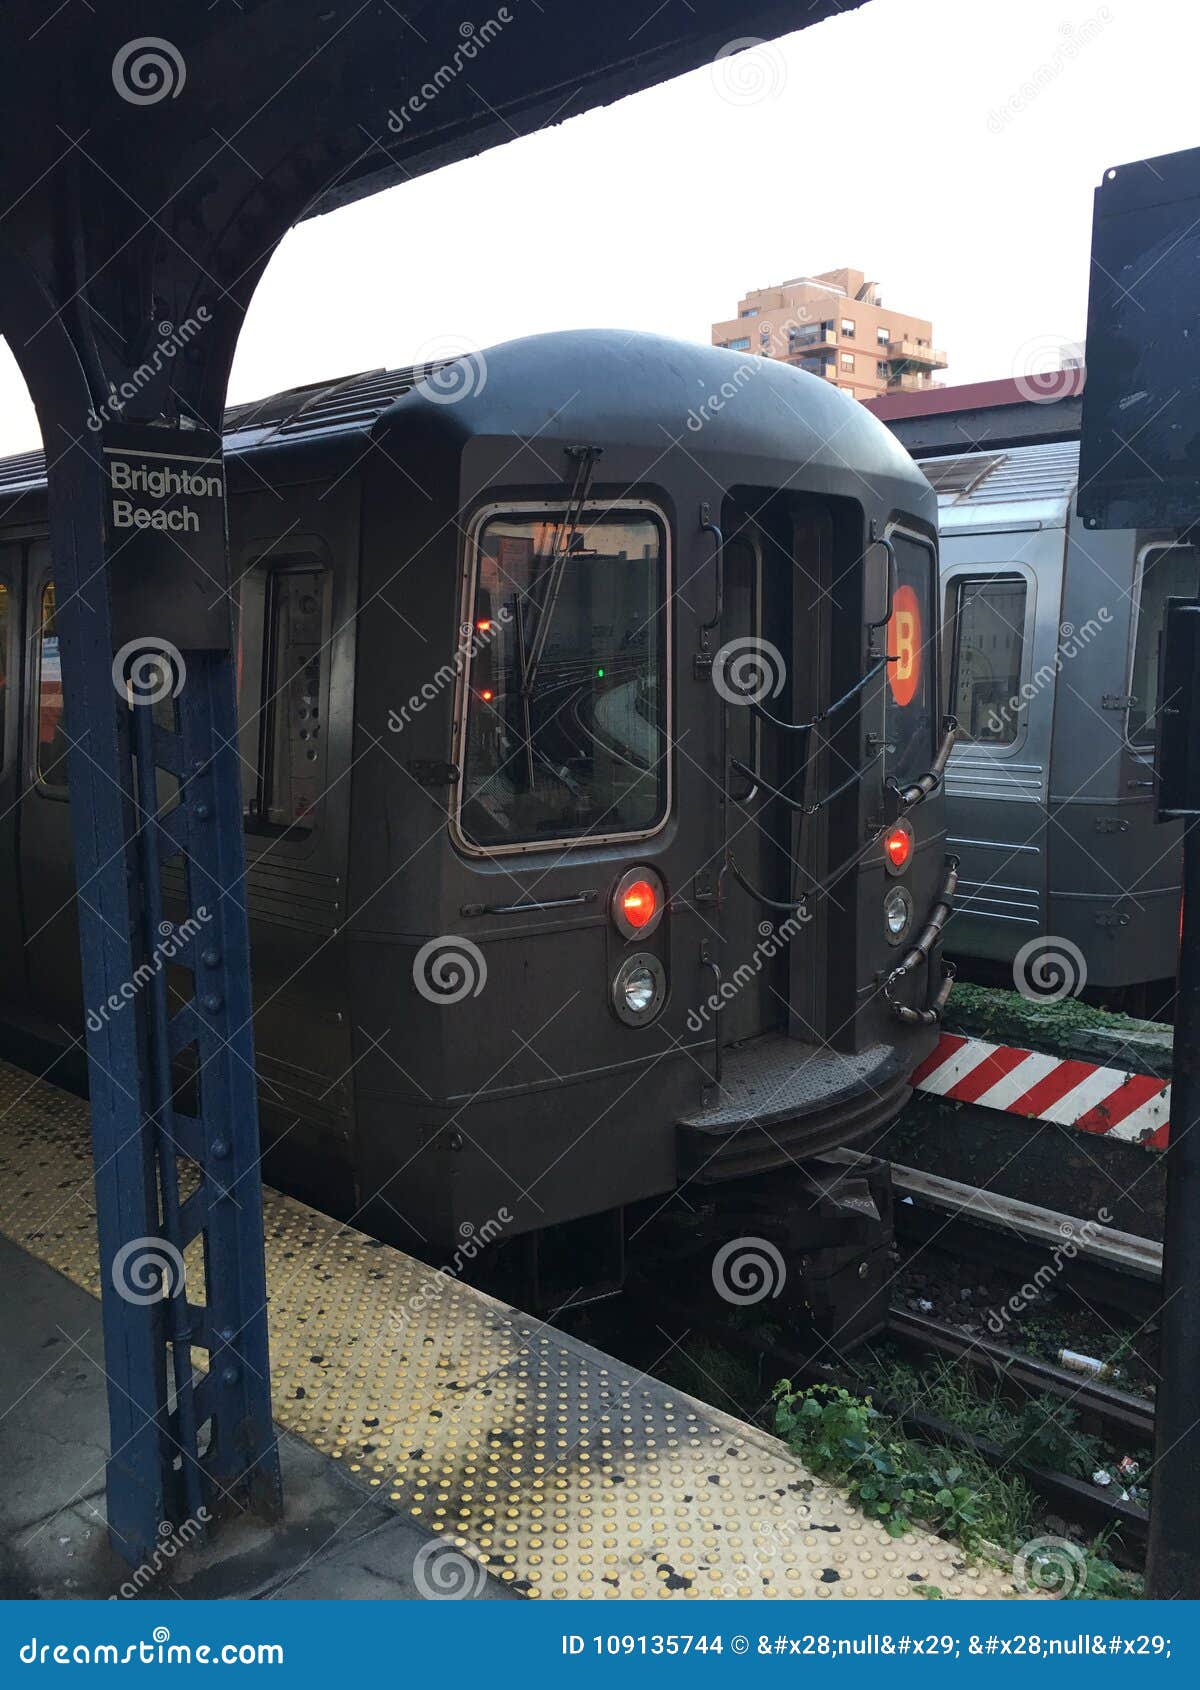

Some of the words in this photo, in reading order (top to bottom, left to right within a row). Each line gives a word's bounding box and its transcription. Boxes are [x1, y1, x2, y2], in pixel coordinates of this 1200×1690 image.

[110, 461, 223, 498] Brighton
[112, 500, 200, 532] Beach
[896, 611, 914, 680] B
